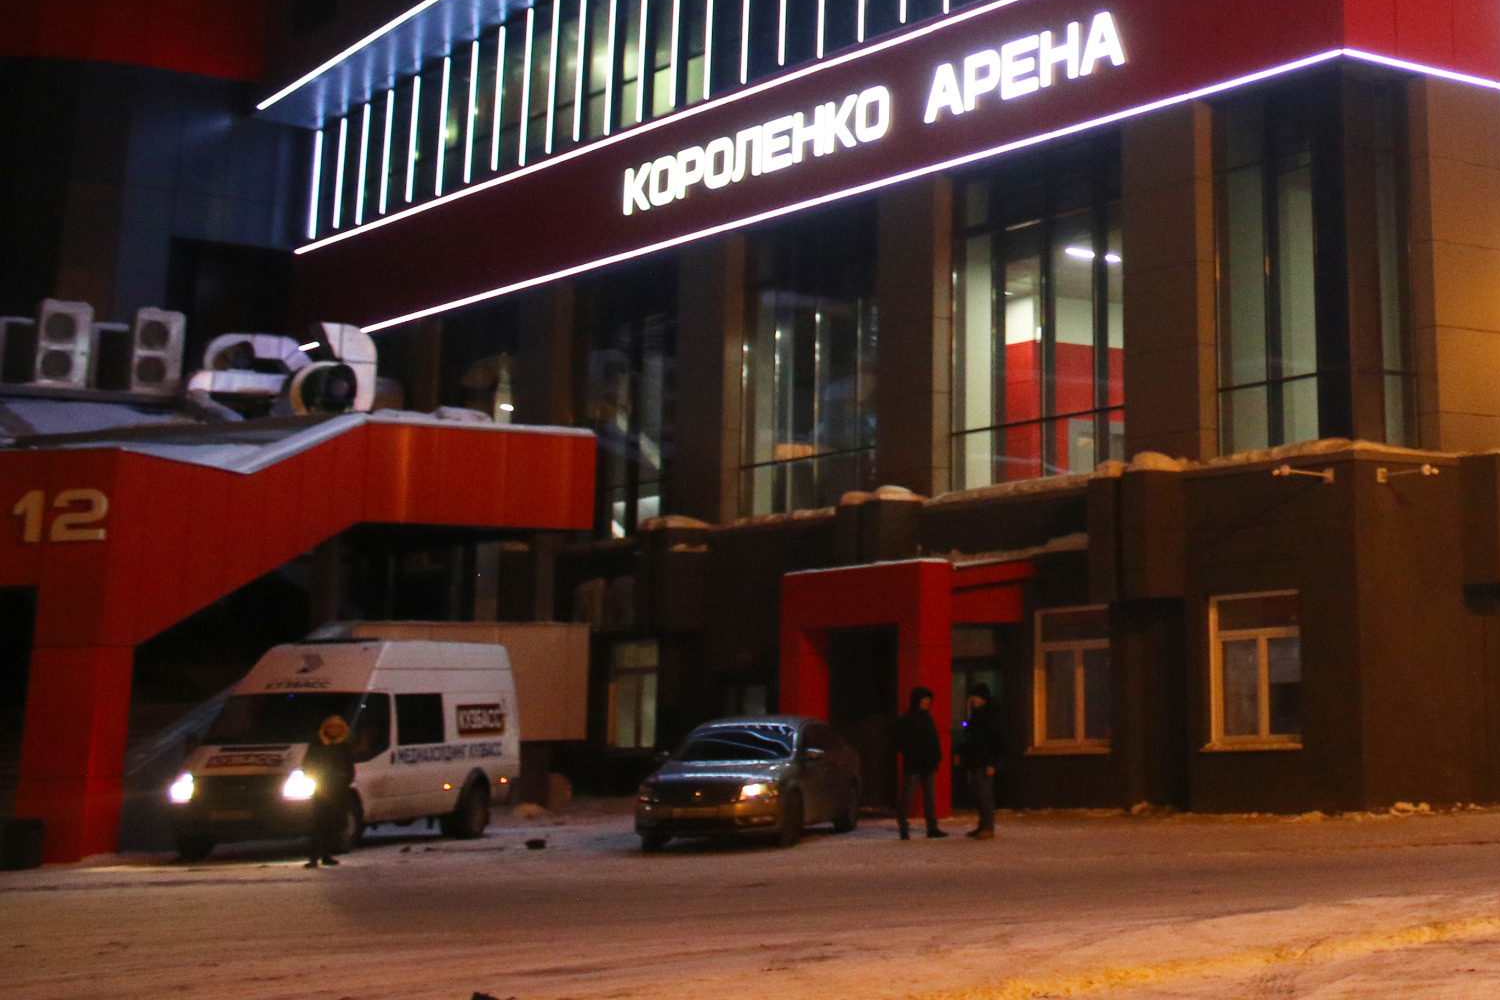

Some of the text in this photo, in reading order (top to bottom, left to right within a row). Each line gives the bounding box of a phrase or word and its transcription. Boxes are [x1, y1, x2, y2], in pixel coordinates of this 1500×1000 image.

[621, 10, 1127, 216] КОРОЛЕНКО АРЕНА
[12, 488, 110, 542] 12
